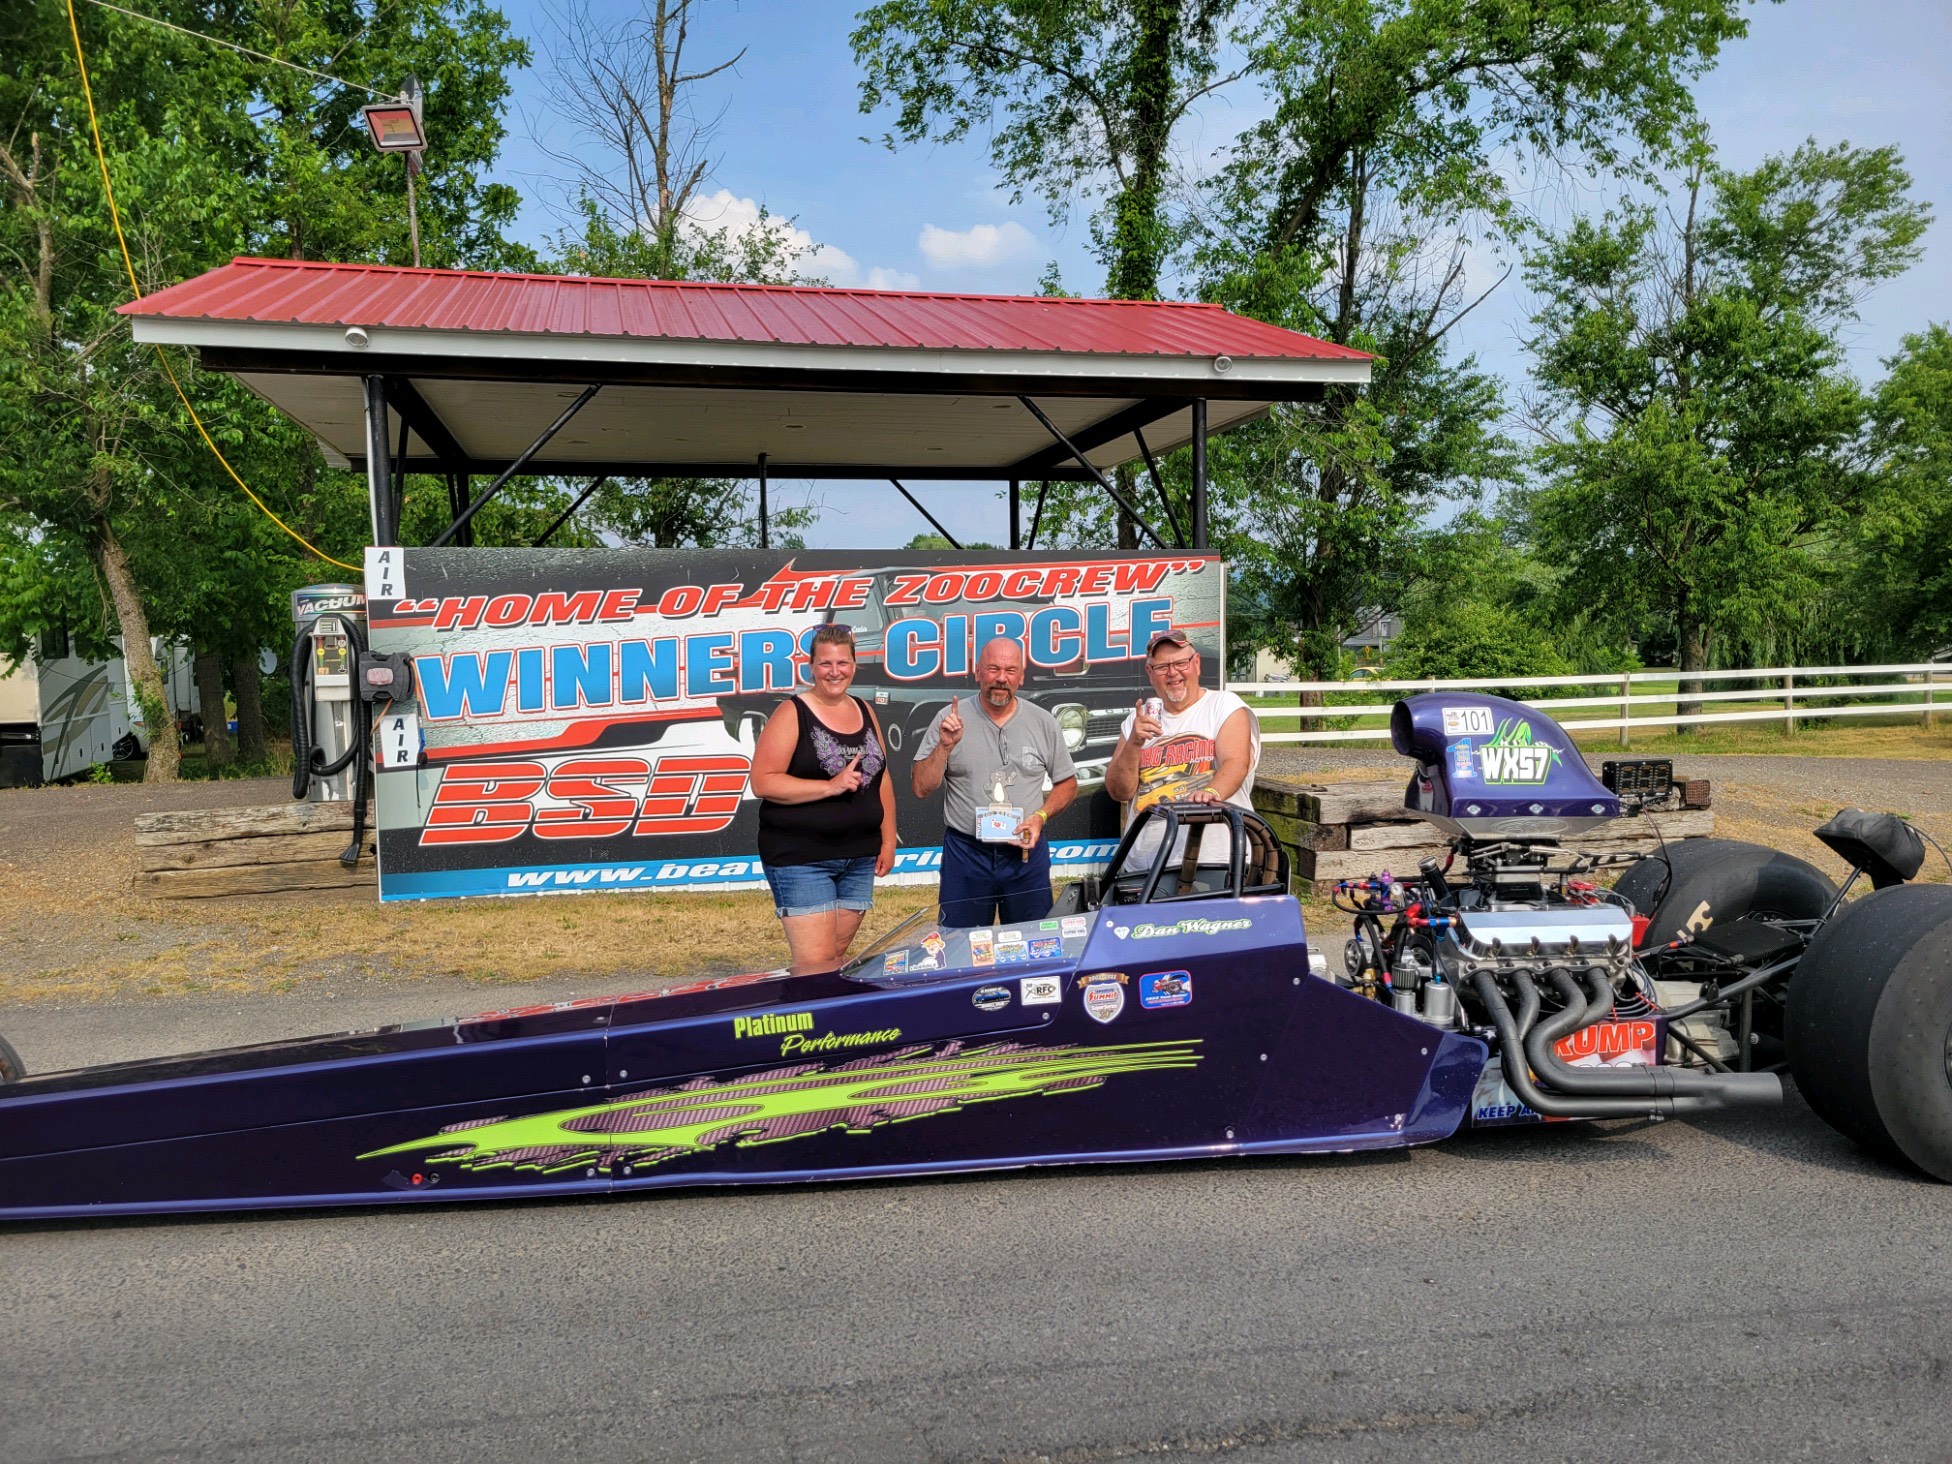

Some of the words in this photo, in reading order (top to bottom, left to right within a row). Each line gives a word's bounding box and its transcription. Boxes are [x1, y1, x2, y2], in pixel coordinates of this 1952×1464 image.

[378, 551, 393, 596] AIR
[657, 583, 744, 619] OF
[759, 576, 875, 613] THE
[1461, 710, 1489, 731] 101
[393, 717, 409, 763] AIR
[418, 754, 752, 847] BSD
[1131, 923, 1180, 939] Dan
[1177, 918, 1252, 935] Wagner
[1036, 985, 1055, 994] RFC
[733, 1012, 815, 1039] Platinum
[780, 1028, 903, 1057] Performance
[1477, 1105, 1516, 1119] KEEP
